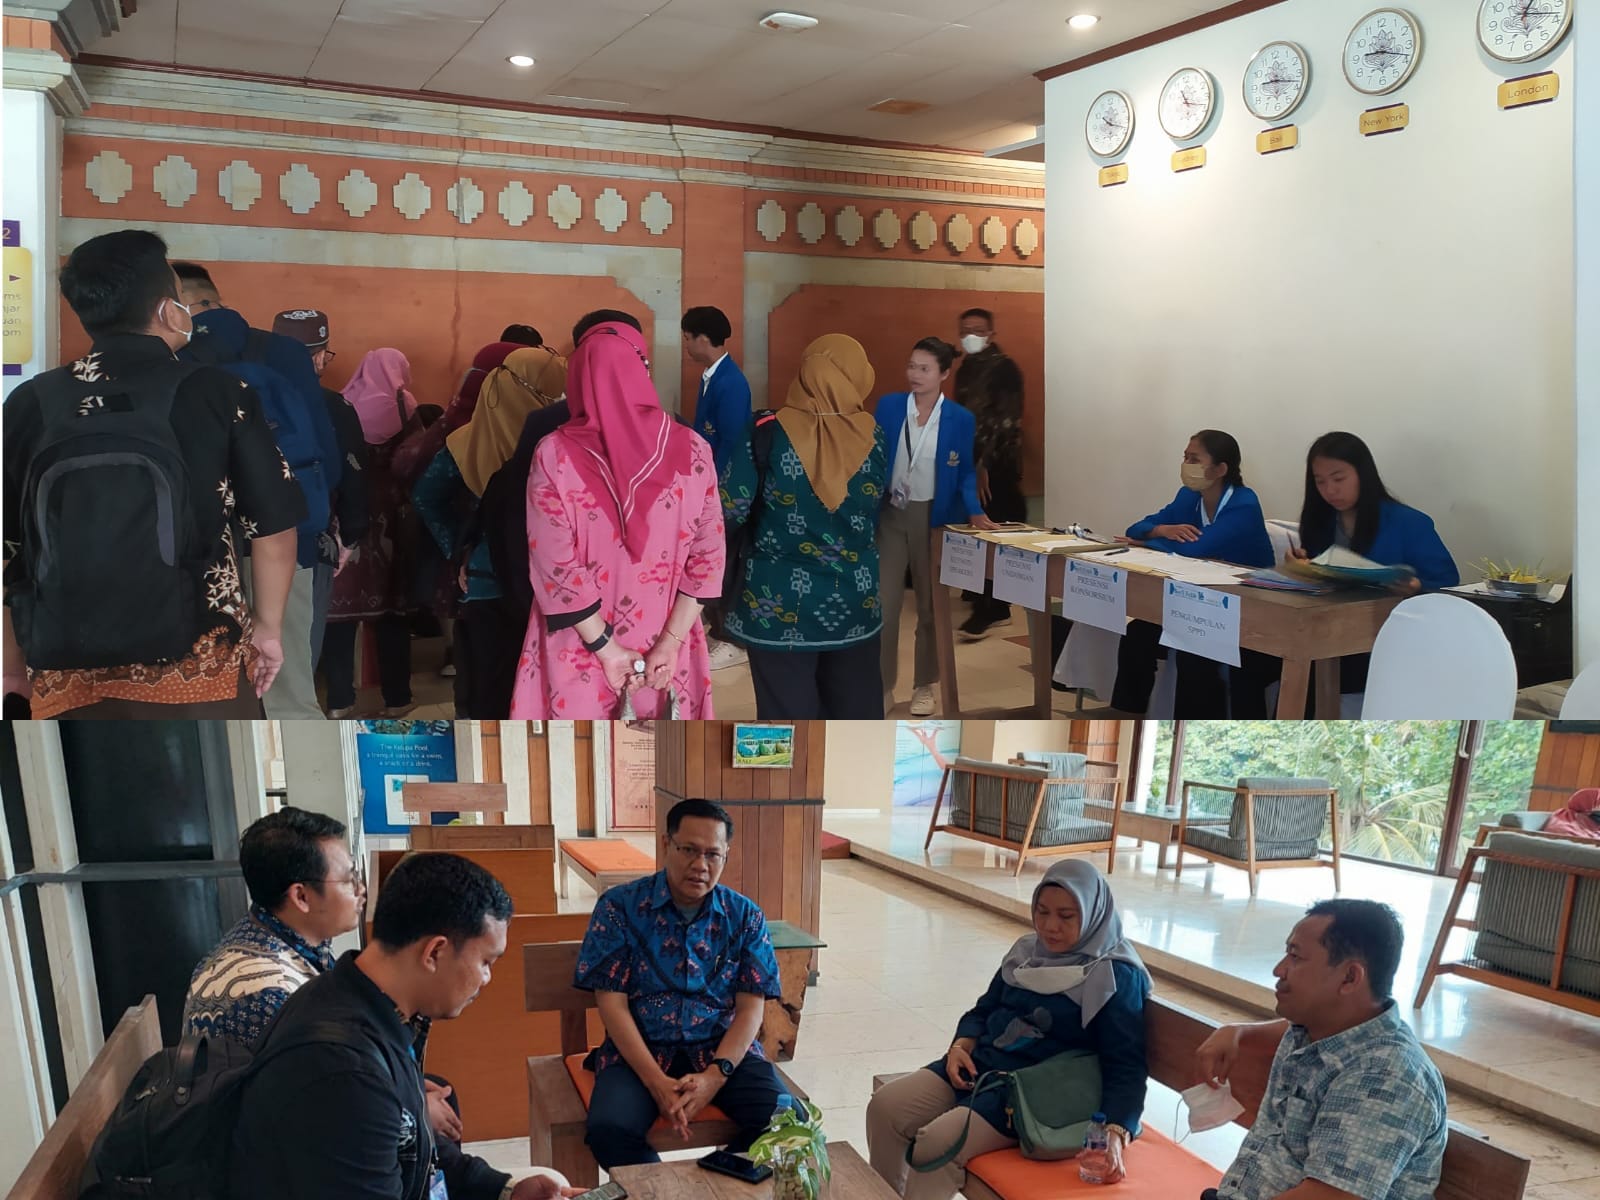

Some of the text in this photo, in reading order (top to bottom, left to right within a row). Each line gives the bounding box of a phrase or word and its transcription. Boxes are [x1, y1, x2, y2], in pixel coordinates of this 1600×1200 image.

[1492, 2, 1504, 14] 10
[1377, 18, 1386, 28] 12
[1552, 14, 1560, 24] 4
[1400, 26, 1409, 36] 2
[1488, 20, 1498, 31] 9
[1494, 34, 1504, 45] 8
[1540, 30, 1550, 40] 5
[1405, 40, 1412, 50] 3
[1507, 41, 1515, 52] 7
[1524, 40, 1533, 51] 6
[1270, 50, 1280, 59] 12
[1352, 54, 1360, 64] 9
[1292, 57, 1298, 66] 2
[1392, 69, 1400, 78] 5
[1378, 76, 1387, 86] 6
[1508, 84, 1549, 99] London
[1363, 113, 1404, 127] New York
[3, 227, 12, 240] 2
[1078, 576, 1108, 590] PRESENSI
[1070, 586, 1115, 603] KONSORSIUM
[1170, 610, 1226, 630] PENGUMPULAN
[1188, 626, 1206, 637] SPPD
